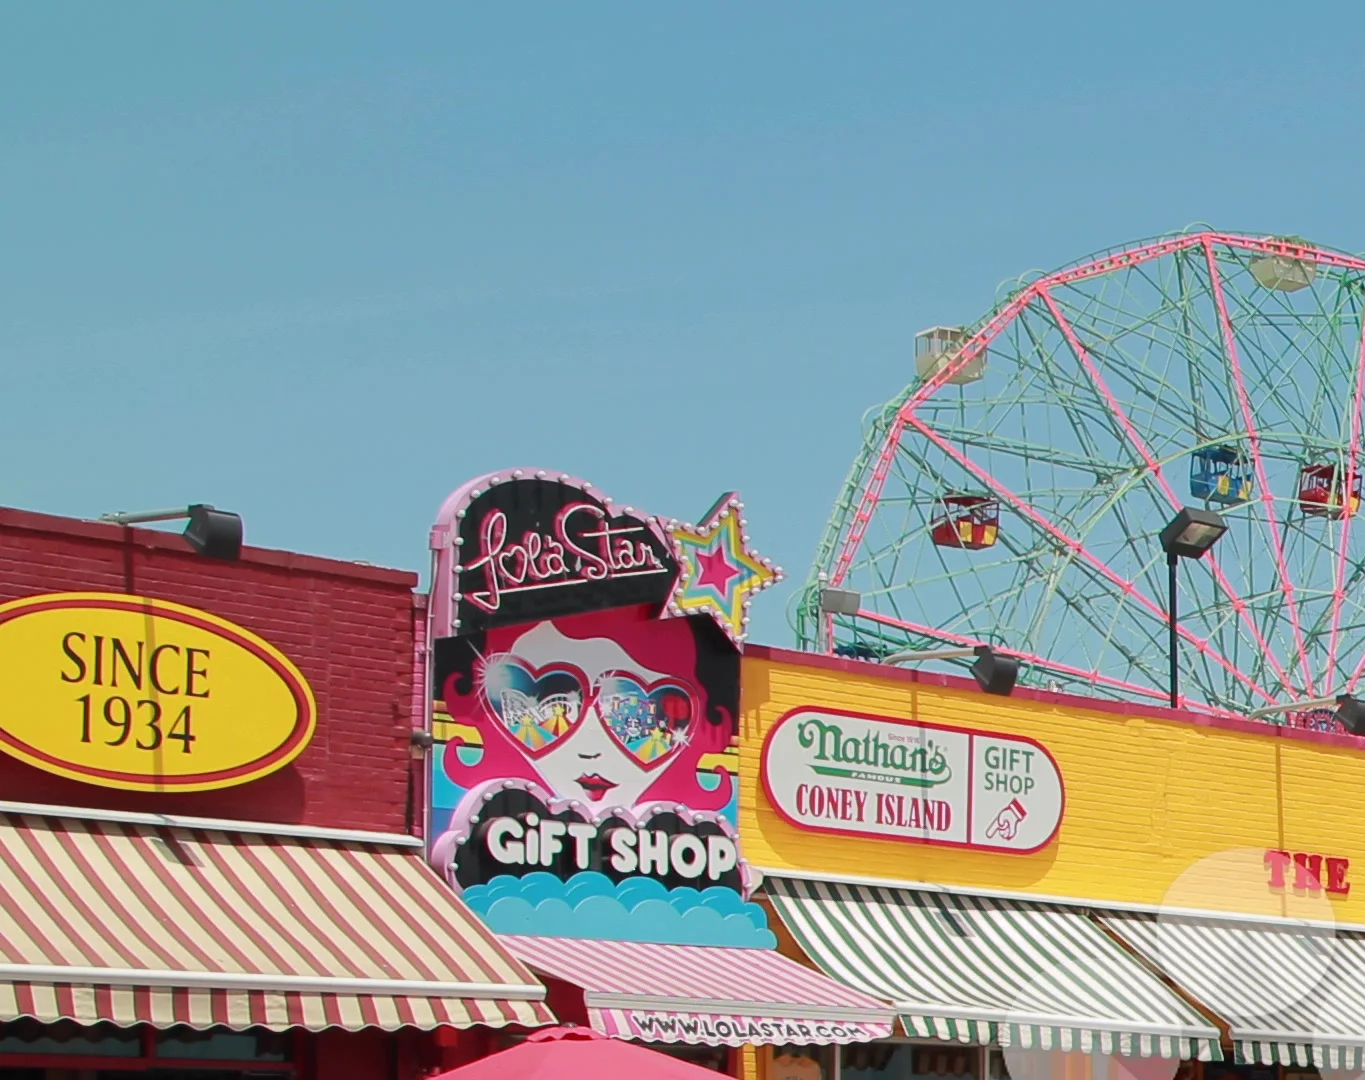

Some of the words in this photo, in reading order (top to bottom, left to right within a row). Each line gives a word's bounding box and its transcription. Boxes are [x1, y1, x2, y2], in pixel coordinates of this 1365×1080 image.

[555, 503, 663, 581] Star
[61, 631, 211, 698] SINCE
[74, 693, 196, 754] 1934
[798, 719, 950, 776] Nathan's
[984, 746, 1035, 773] GIFT
[984, 772, 1035, 795] SHOP
[796, 784, 868, 822] CONEY
[876, 793, 952, 832] ISLAND
[610, 827, 737, 880] SHOP
[1264, 850, 1351, 895] THE
[633, 1015, 868, 1038] WWW.LOLASTAR.COM
